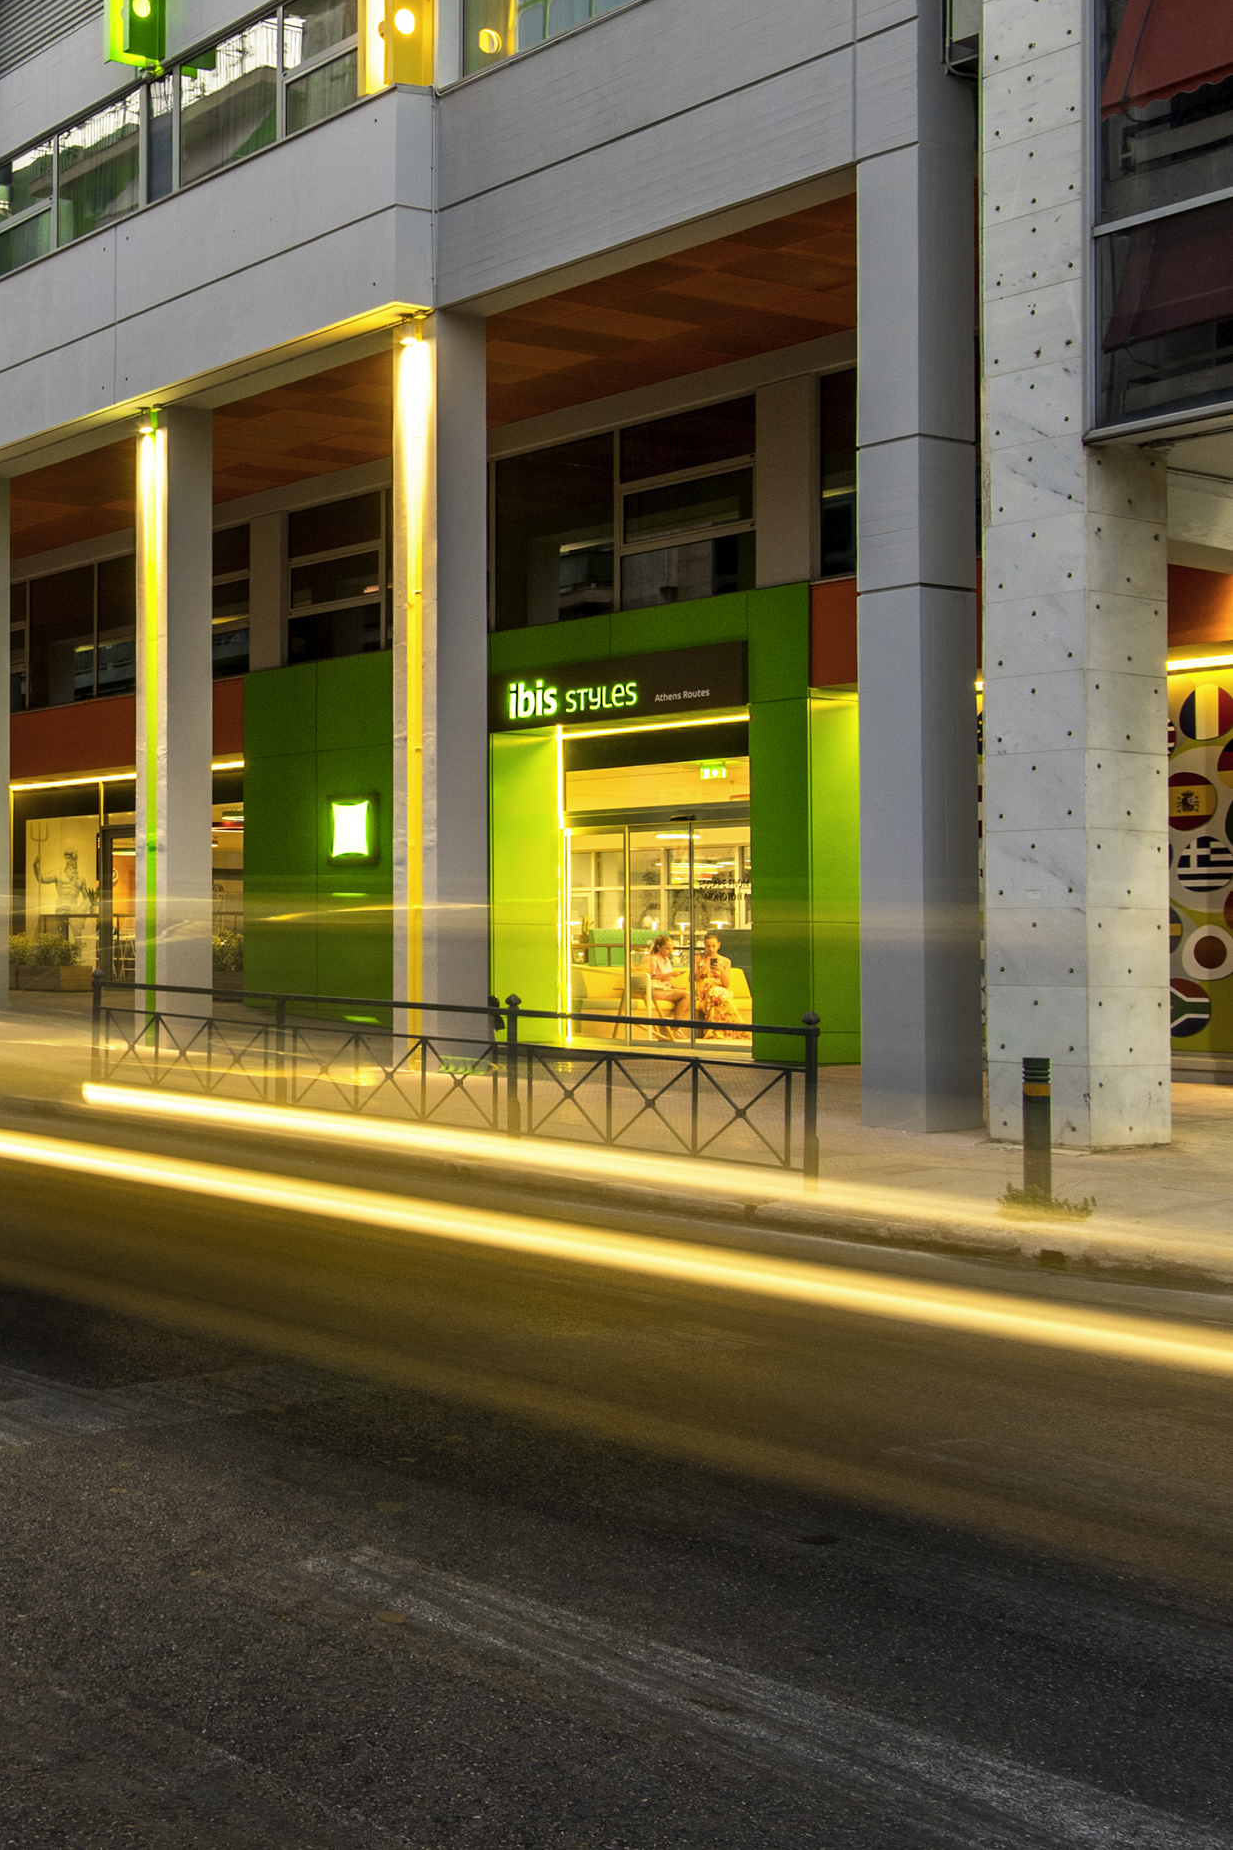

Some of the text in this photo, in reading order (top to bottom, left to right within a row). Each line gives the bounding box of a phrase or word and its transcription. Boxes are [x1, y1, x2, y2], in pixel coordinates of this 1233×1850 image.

[509, 680, 558, 719] ibis
[655, 690, 710, 702] Athens Routes
